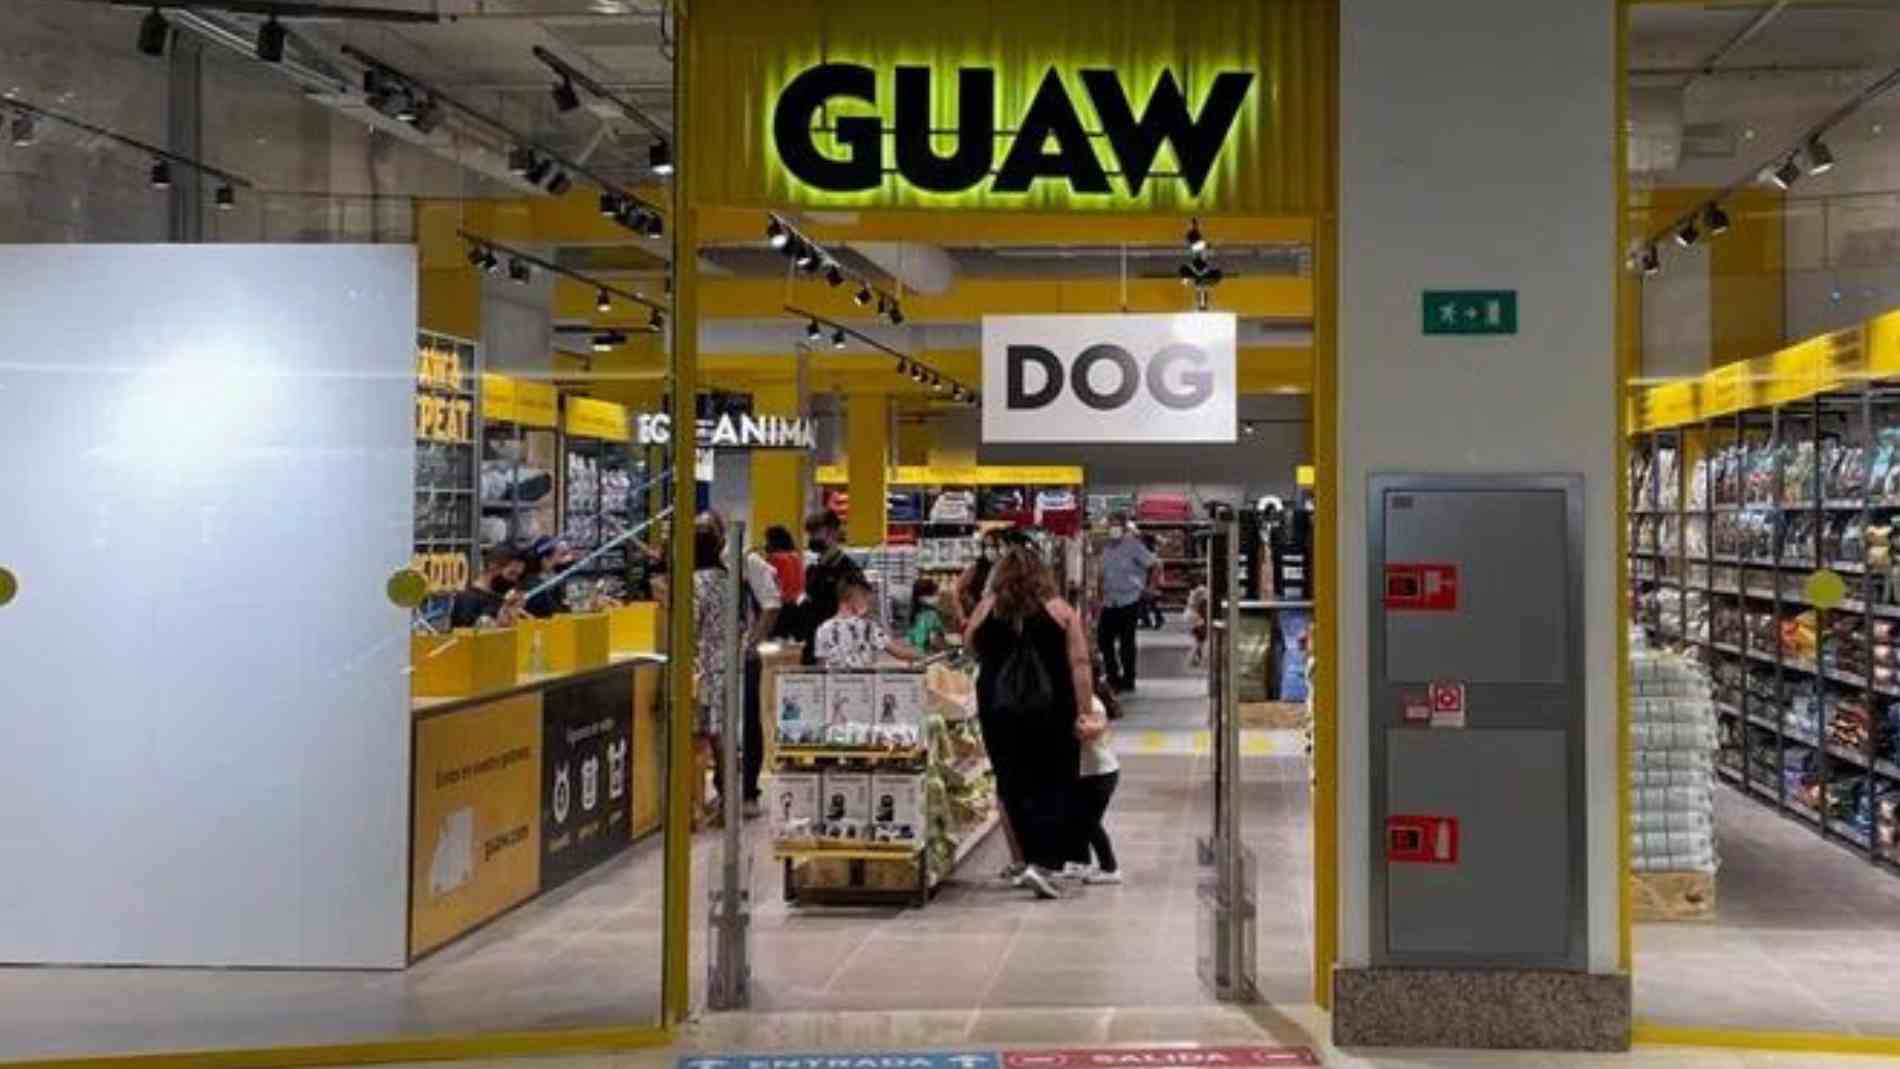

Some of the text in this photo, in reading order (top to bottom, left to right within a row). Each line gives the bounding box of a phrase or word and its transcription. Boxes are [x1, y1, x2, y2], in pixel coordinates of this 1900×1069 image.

[773, 61, 1255, 198] GUAW
[1006, 343, 1214, 411] DOG
[1091, 1052, 1231, 1064] SALIDA
